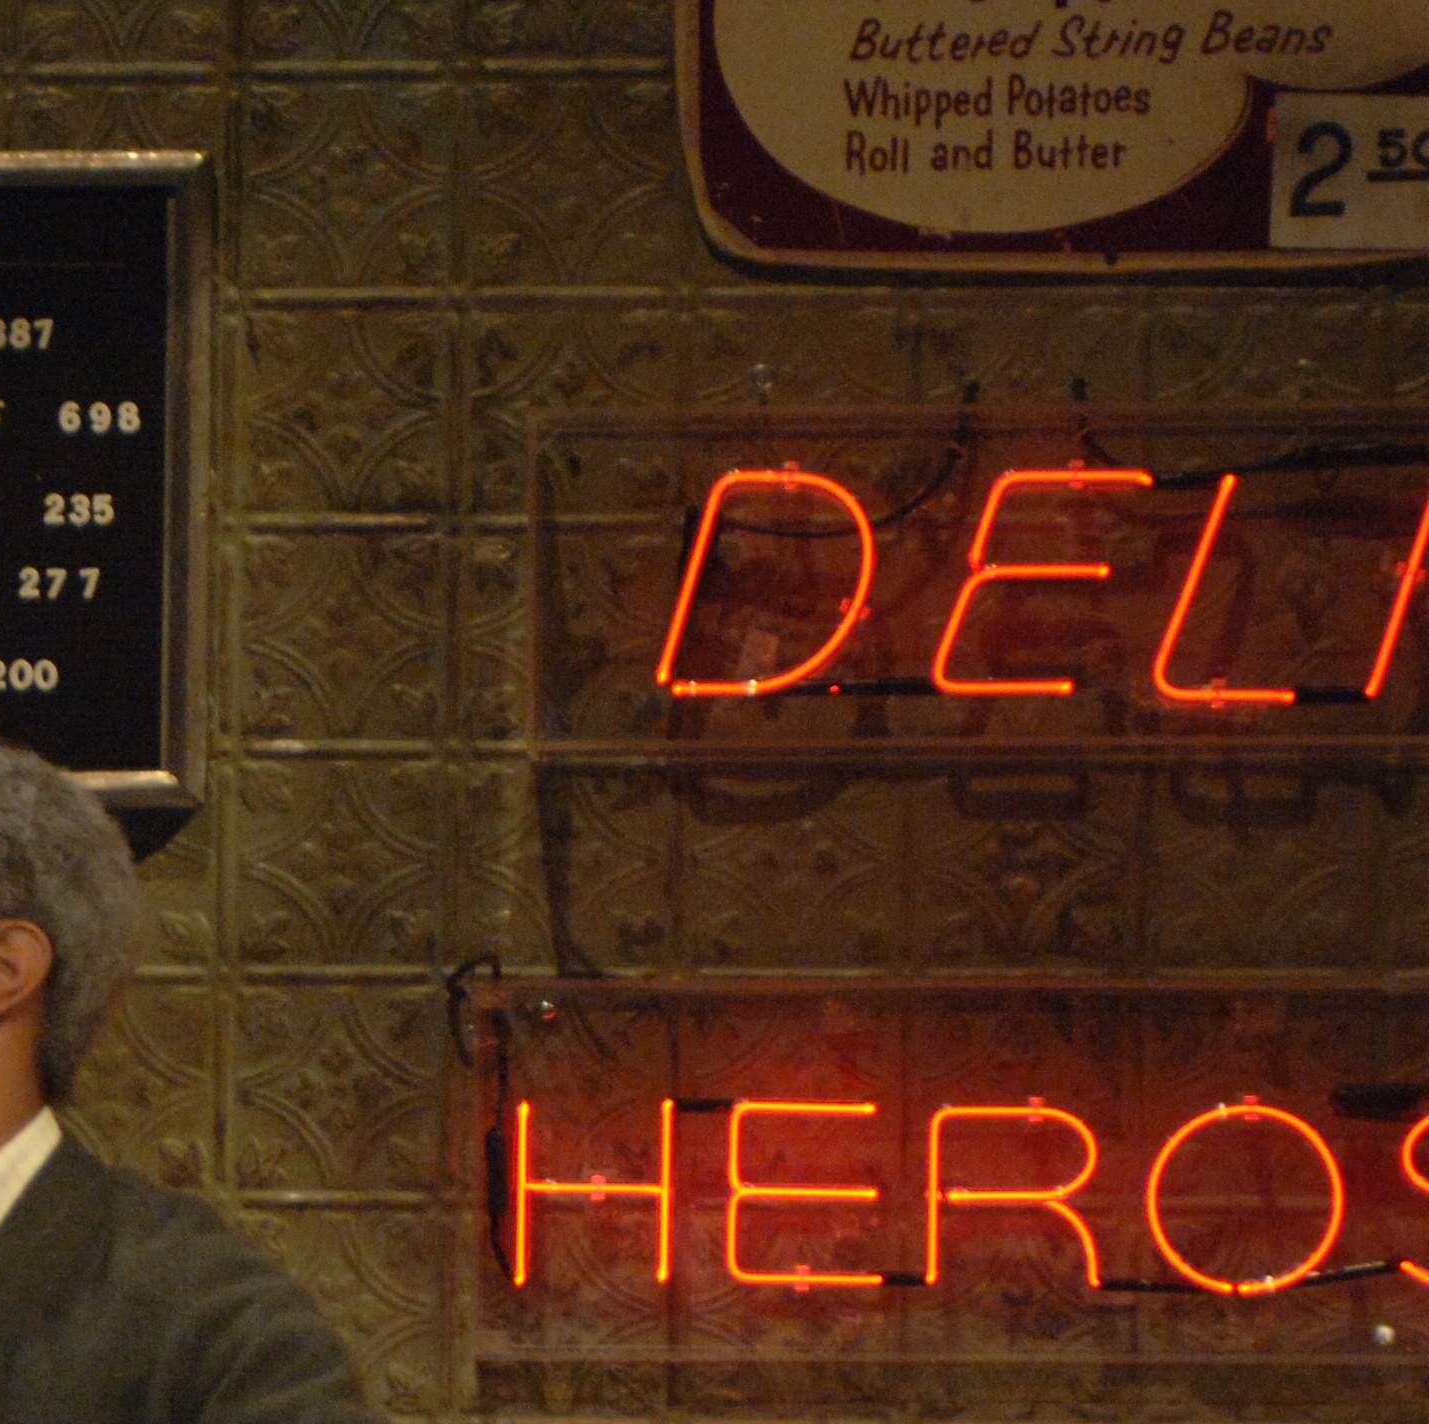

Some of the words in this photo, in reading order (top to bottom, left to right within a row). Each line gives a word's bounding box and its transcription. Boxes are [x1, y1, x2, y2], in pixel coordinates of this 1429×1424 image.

[849, 17, 1043, 63] Buttered
[1051, 13, 1183, 64] String
[1200, 11, 1333, 57] Beans
[843, 74, 993, 128] Whipped
[1007, 73, 1153, 118] Potatoes
[844, 131, 910, 174] Roll
[929, 131, 993, 171] and
[1013, 130, 1128, 171] Butter
[58, 400, 141, 434] 698
[43, 492, 115, 526] 235
[18, 566, 101, 600] 277
[657, 468, 1429, 702] DELI
[512, 1096, 1429, 1296] HERO
